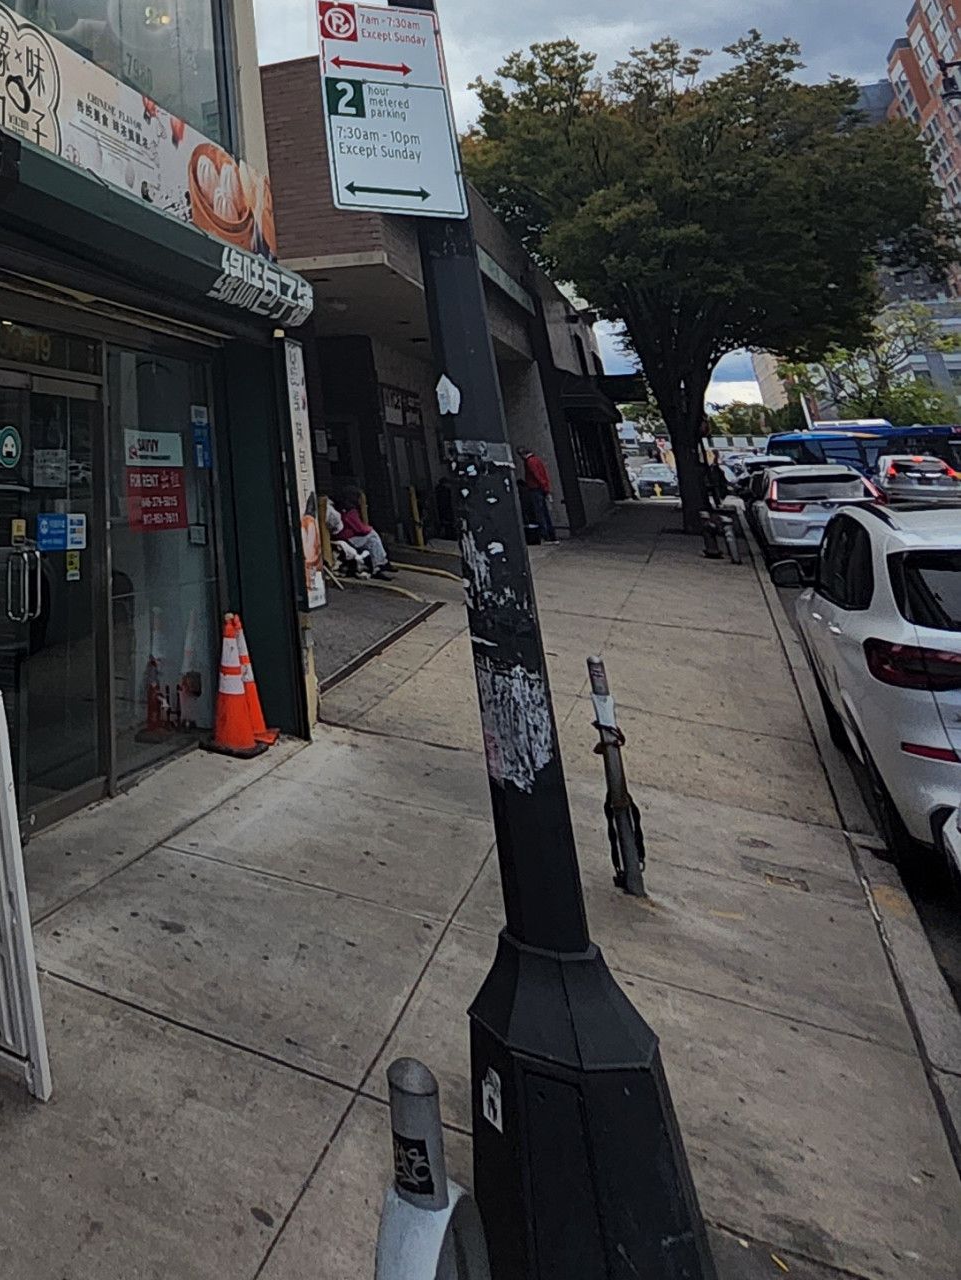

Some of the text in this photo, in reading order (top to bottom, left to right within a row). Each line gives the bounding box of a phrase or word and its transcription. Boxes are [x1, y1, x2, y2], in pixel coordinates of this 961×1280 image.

[359, 13, 380, 26] 7am
[386, 16, 421, 29] 7:30am
[361, 28, 426, 48] Except Sunday
[335, 81, 357, 115] 2
[367, 85, 389, 98] hour
[368, 96, 410, 110] metered
[370, 108, 407, 122] parking
[336, 126, 380, 141] 7:30am
[389, 131, 421, 147] 10pm
[338, 142, 422, 164] Except Sunday
